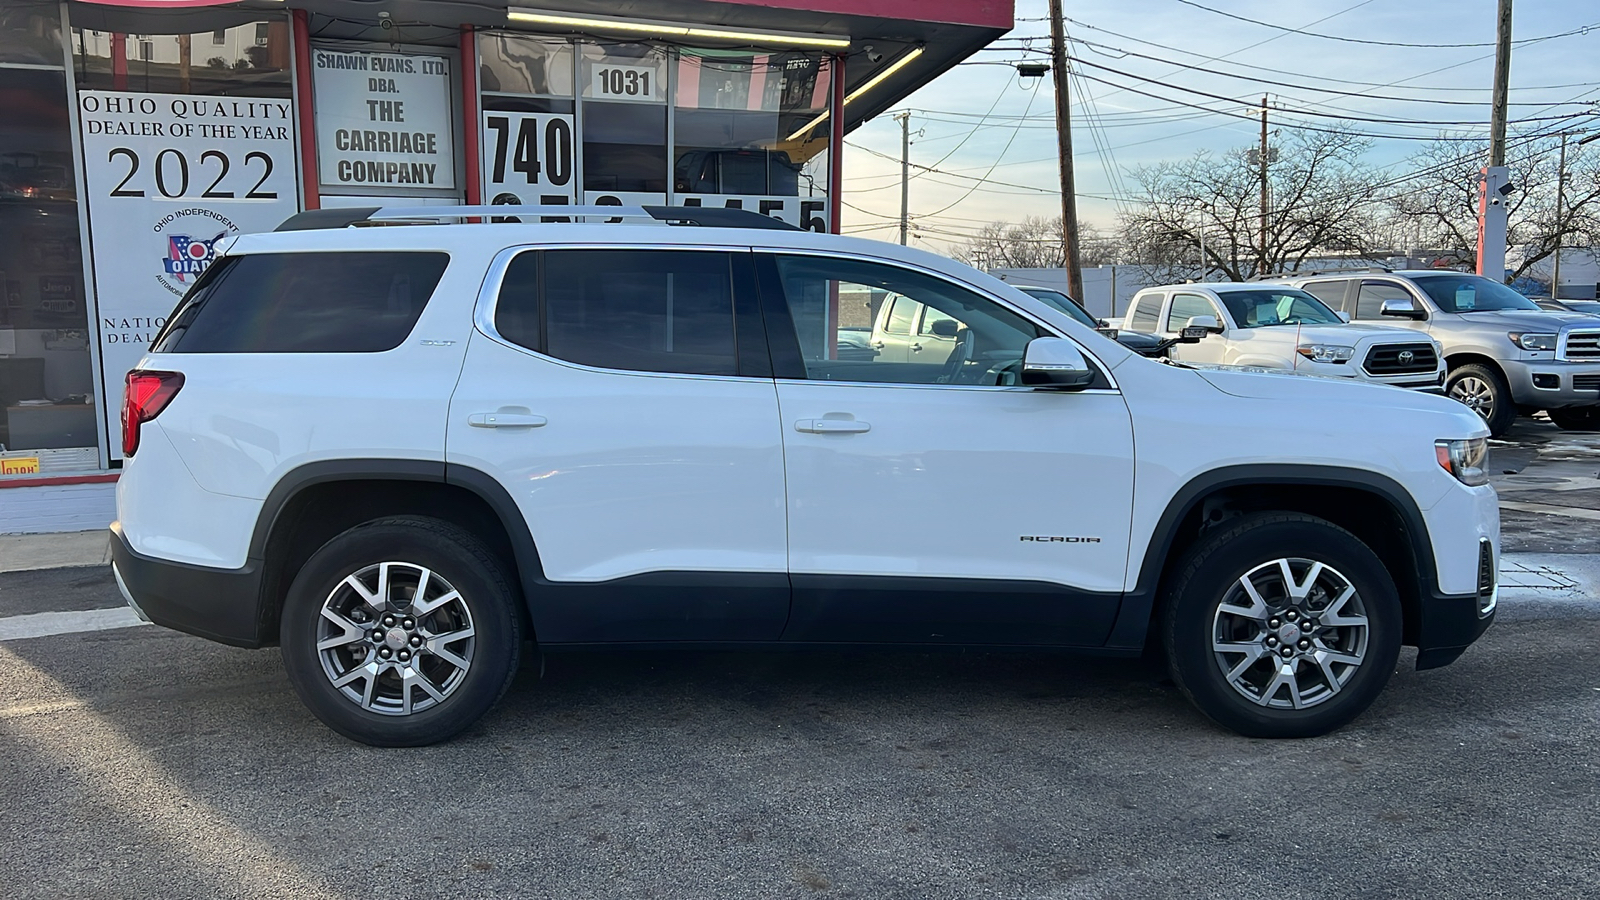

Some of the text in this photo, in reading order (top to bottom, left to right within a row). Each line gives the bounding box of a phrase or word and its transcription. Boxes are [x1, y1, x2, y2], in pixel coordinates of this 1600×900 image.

[316, 53, 448, 76] SHAWN EVANS. LTD.
[368, 77, 400, 94] DBA.
[598, 68, 650, 96] 1031
[82, 95, 290, 120] OHIO QUALITY
[366, 99, 405, 123] THE
[87, 119, 289, 140] DEALER OF THE YEAR
[335, 128, 437, 155] CARRIAGE
[487, 116, 572, 186] 740
[108, 146, 278, 199] 2022
[337, 159, 437, 185] COMPANY
[153, 208, 240, 233] OHIO INDEPENDENT
[171, 259, 212, 273] OIAD
[155, 274, 185, 298] AUTOMOBIL
[104, 316, 167, 330] NATIO
[107, 332, 155, 344] DEAL
[1020, 535, 1101, 543] ACADIA
